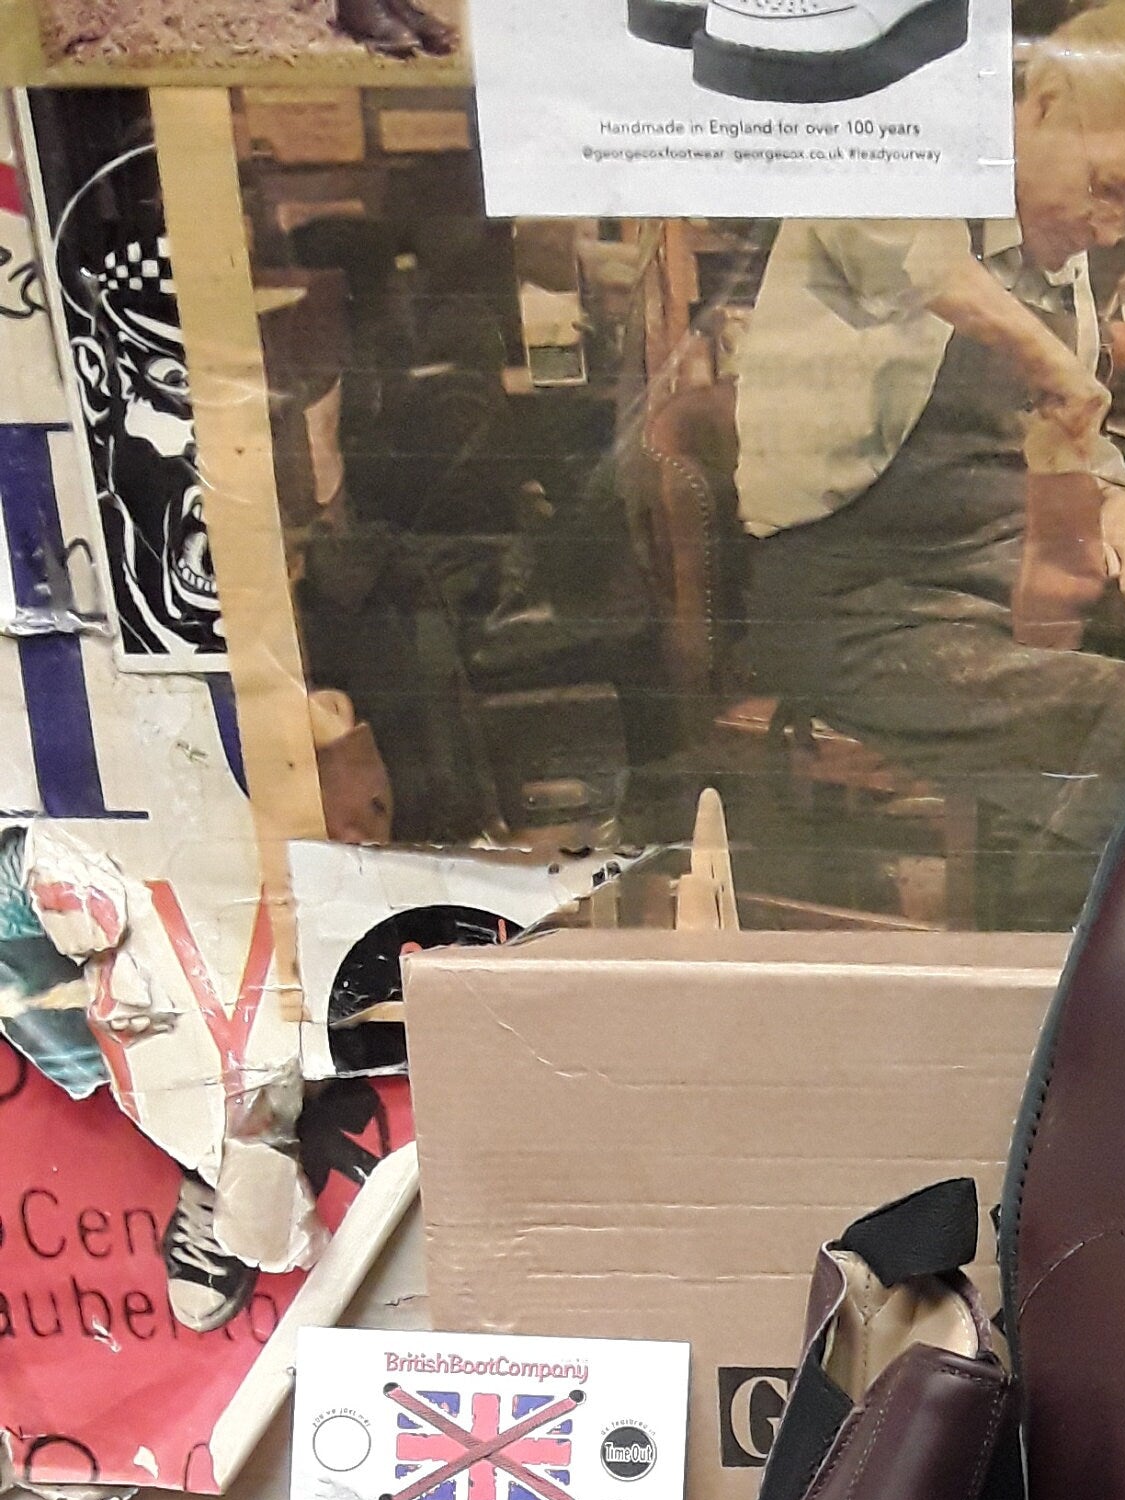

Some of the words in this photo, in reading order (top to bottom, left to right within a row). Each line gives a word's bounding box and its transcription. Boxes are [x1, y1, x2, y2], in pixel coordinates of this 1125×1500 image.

[599, 120, 685, 135] Handmade
[690, 121, 703, 135] in
[709, 120, 773, 137] England
[778, 120, 799, 135] for
[806, 122, 840, 135] over
[847, 120, 874, 135] 100
[879, 122, 920, 138] years
[384, 1351, 589, 1384] BritishBootCompany
